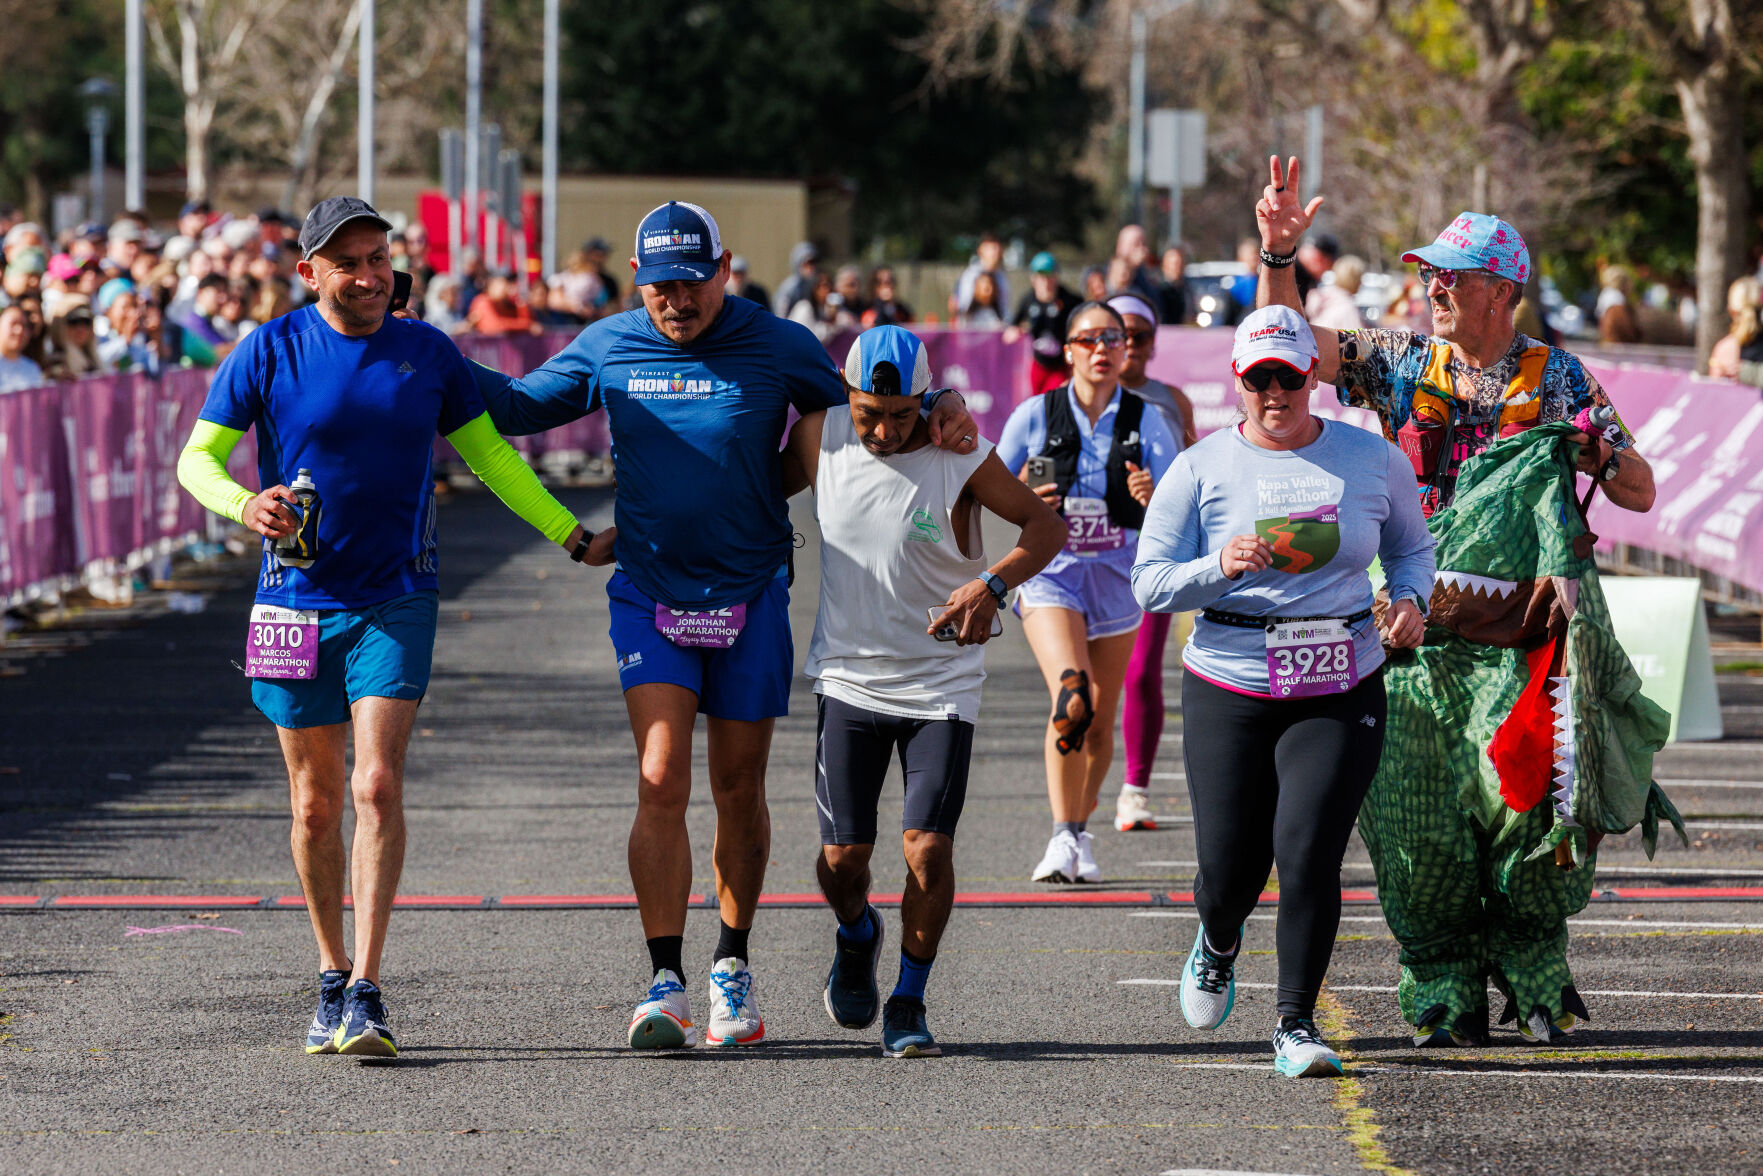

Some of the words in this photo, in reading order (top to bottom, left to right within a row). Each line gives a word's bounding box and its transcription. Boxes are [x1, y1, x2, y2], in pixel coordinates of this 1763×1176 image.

[643, 233, 701, 249] IRONMAN
[644, 247, 660, 255] WORLD
[1249, 328, 1275, 339] TEAM
[1278, 329, 1297, 338] USA
[628, 378, 712, 393] IRONMAN
[1257, 479, 1289, 493] Napa
[1291, 475, 1330, 490] Valley
[1258, 489, 1329, 506] Marathon
[1321, 513, 1336, 522] 2025
[677, 618, 726, 627] JONATHAN
[253, 624, 303, 648] 3010
[662, 626, 685, 635] HALF
[687, 627, 739, 636] MARATHON
[248, 657, 262, 665] HALF
[263, 658, 310, 667] MARATHON
[1274, 644, 1350, 677] 3928
[1276, 676, 1301, 686] HALF
[1302, 672, 1351, 684] MARATHON
